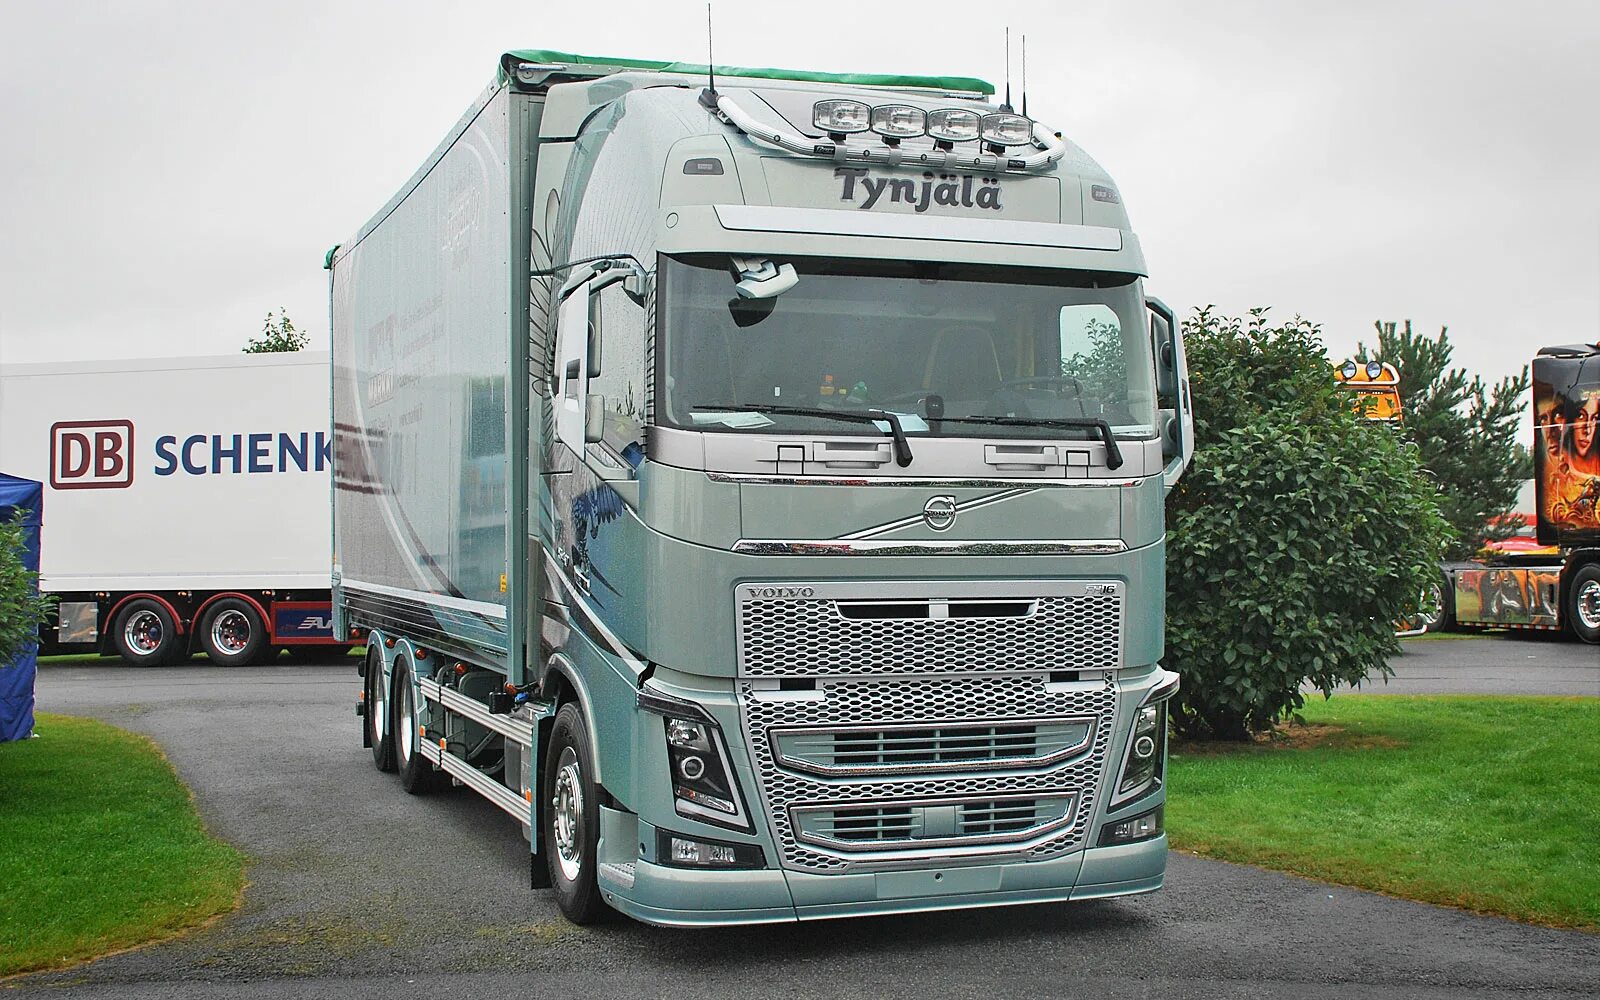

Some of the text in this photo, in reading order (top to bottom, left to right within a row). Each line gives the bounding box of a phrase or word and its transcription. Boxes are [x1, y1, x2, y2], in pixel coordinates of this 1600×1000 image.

[834, 167, 1002, 212] Tynjälä
[60, 432, 124, 478] DB
[925, 509, 956, 517] VOLVO
[746, 586, 815, 598] VOLVO
